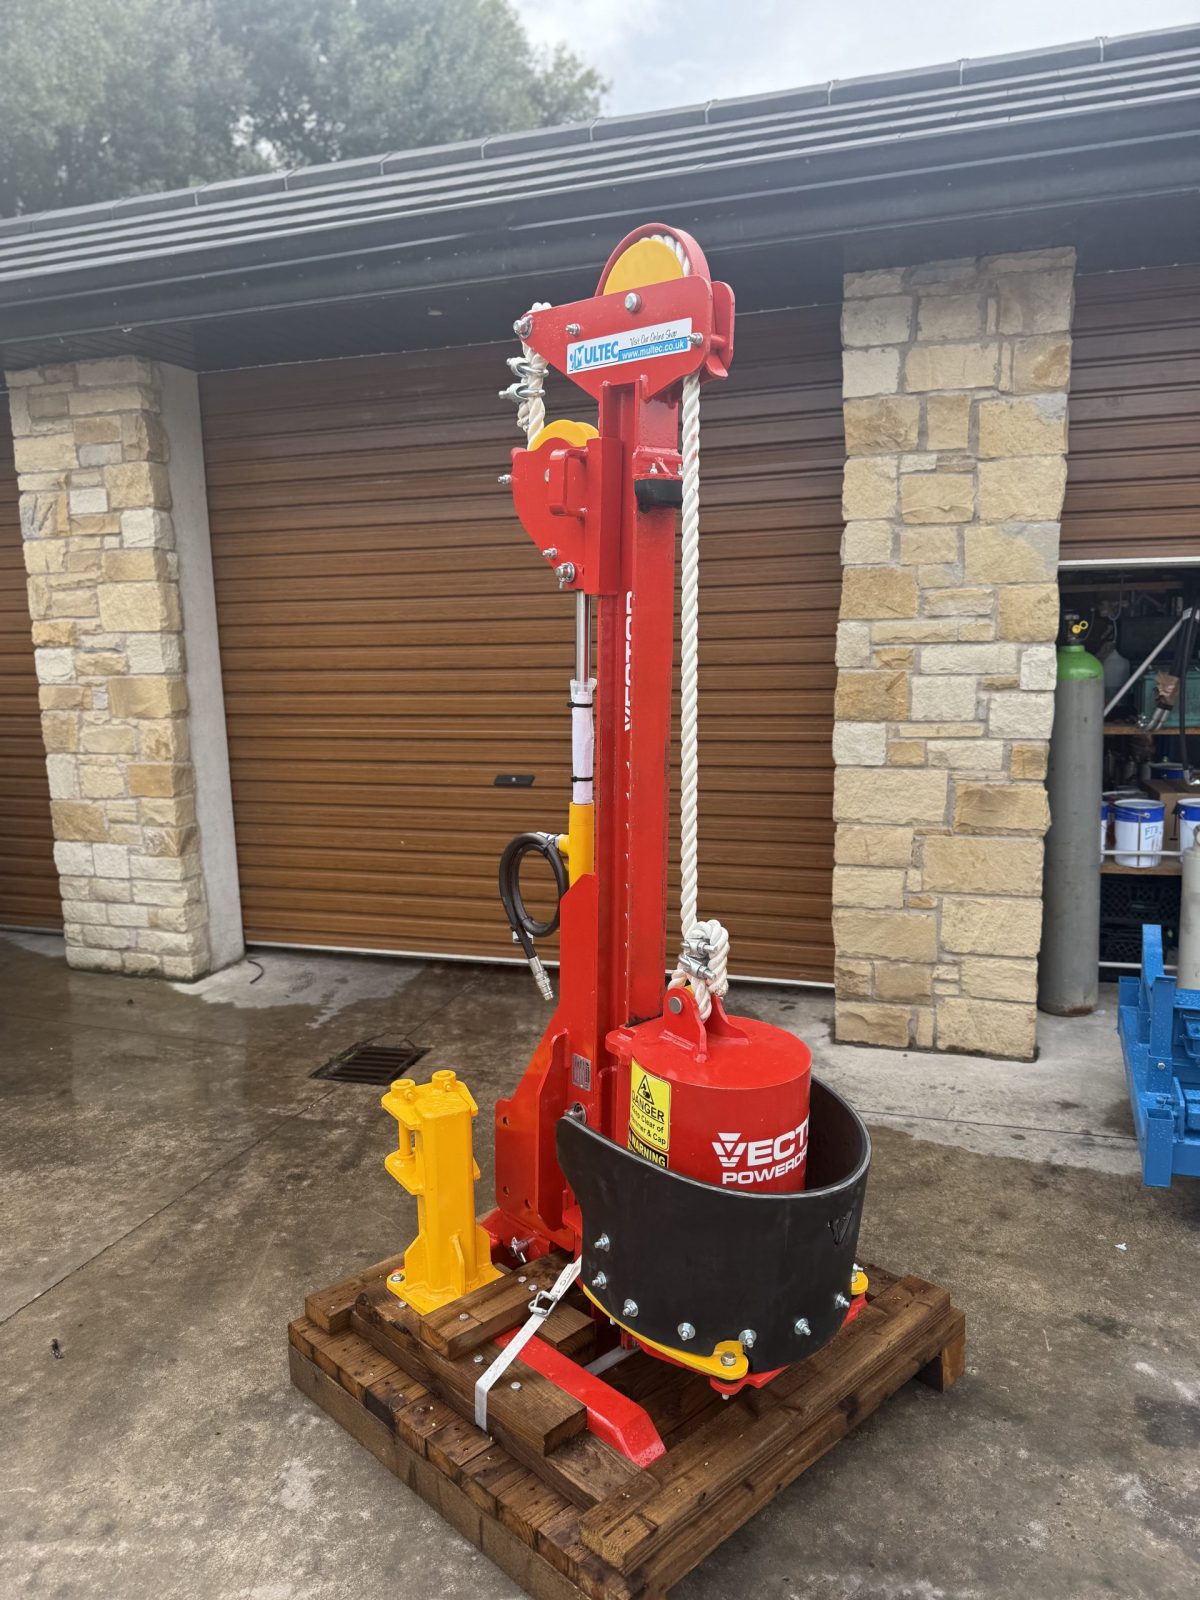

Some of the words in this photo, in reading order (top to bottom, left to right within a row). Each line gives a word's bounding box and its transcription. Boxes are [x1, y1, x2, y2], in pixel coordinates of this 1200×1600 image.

[665, 329, 677, 340] Shop
[571, 341, 619, 370] MULTEC
[622, 342, 684, 359] www.multec.co.uk
[632, 1090, 664, 1122] DANGER
[641, 1115, 655, 1129] Clear
[647, 1130, 651, 1138] &
[653, 1133, 666, 1145] Cap
[712, 1117, 809, 1167] VECT
